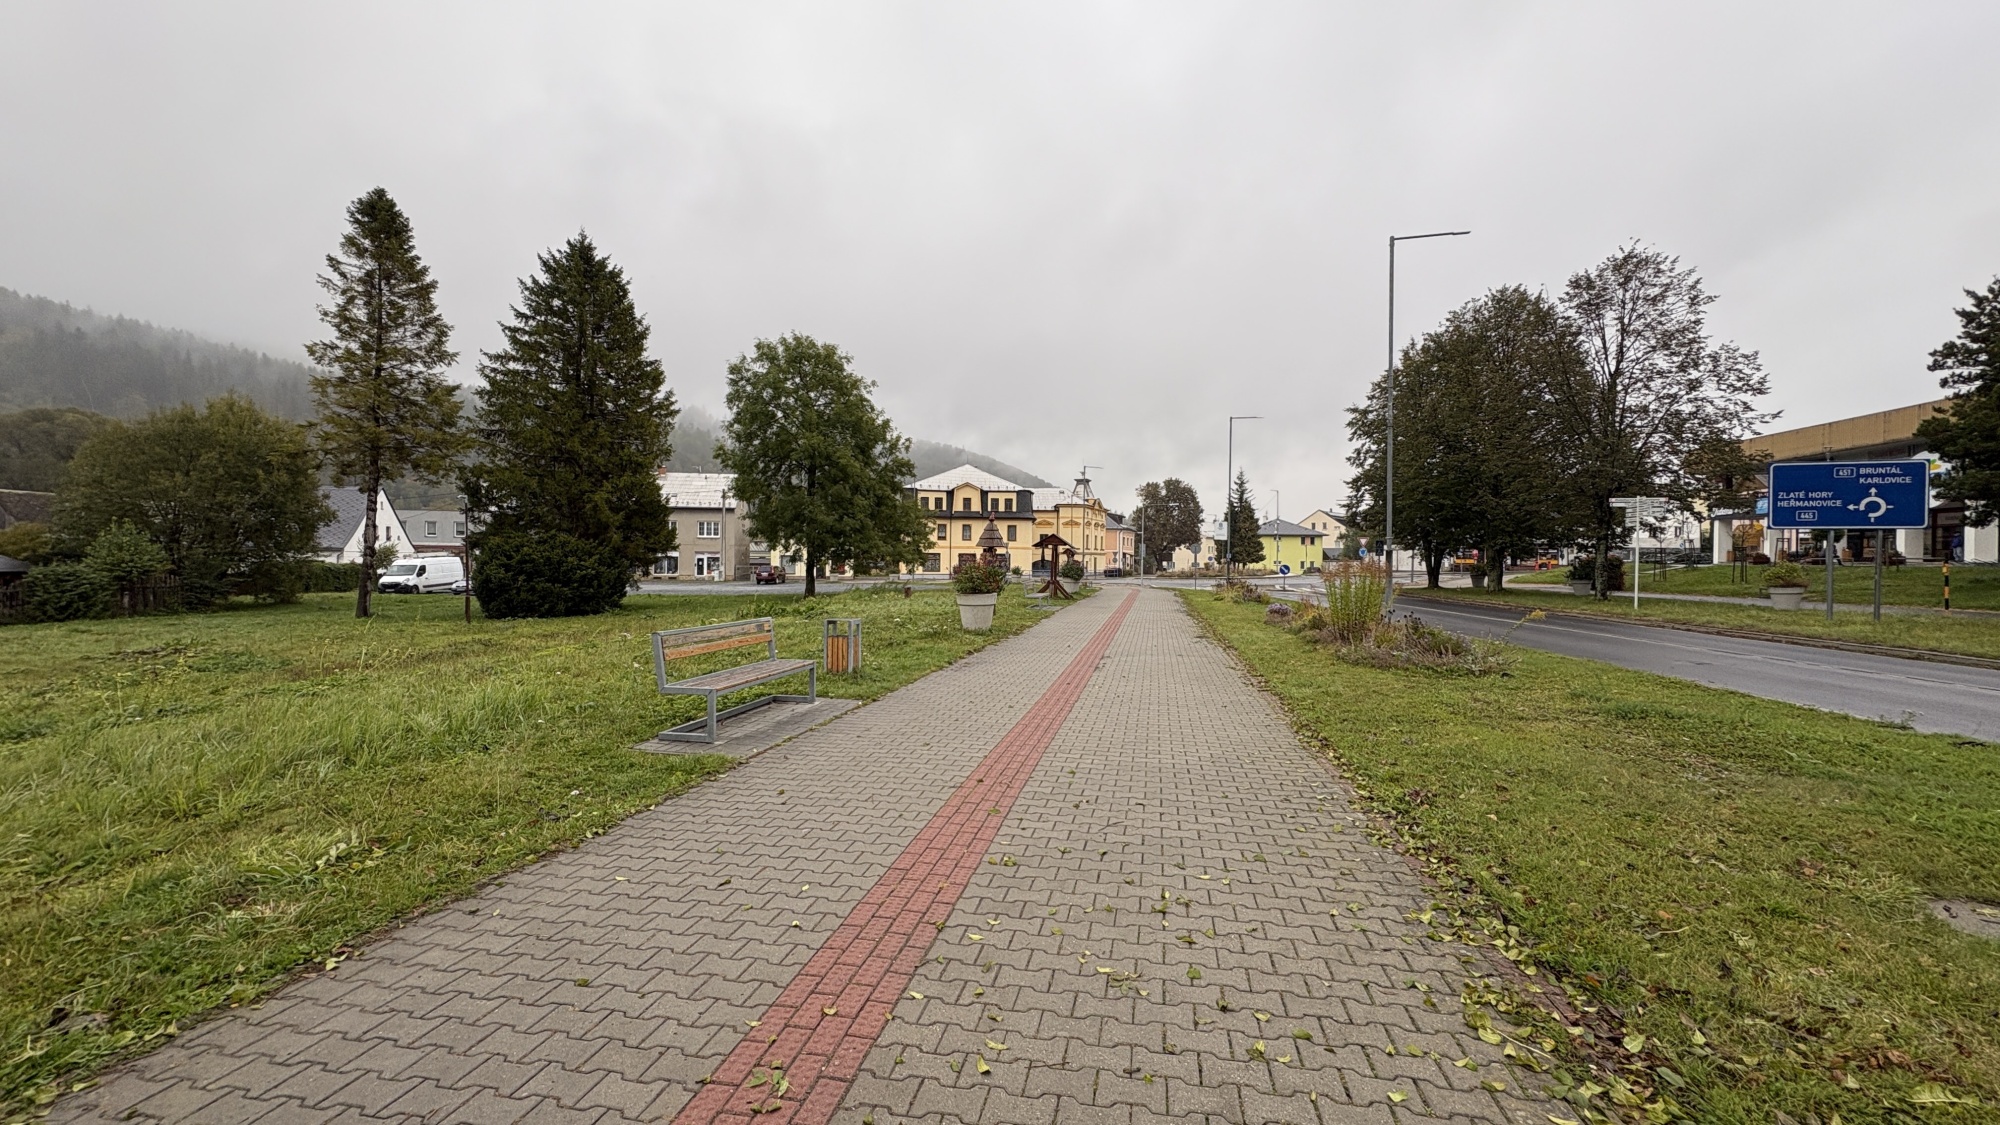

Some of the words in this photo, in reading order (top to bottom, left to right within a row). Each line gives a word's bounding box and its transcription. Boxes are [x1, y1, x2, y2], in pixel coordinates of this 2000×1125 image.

[1859, 465, 1903, 475] BRUNTÁL
[1859, 476, 1913, 484] KARLOVICE
[1777, 490, 1805, 499] ZLATÉ
[1808, 491, 1834, 499] HORY
[1777, 499, 1843, 508] HEŘMANOVICE
